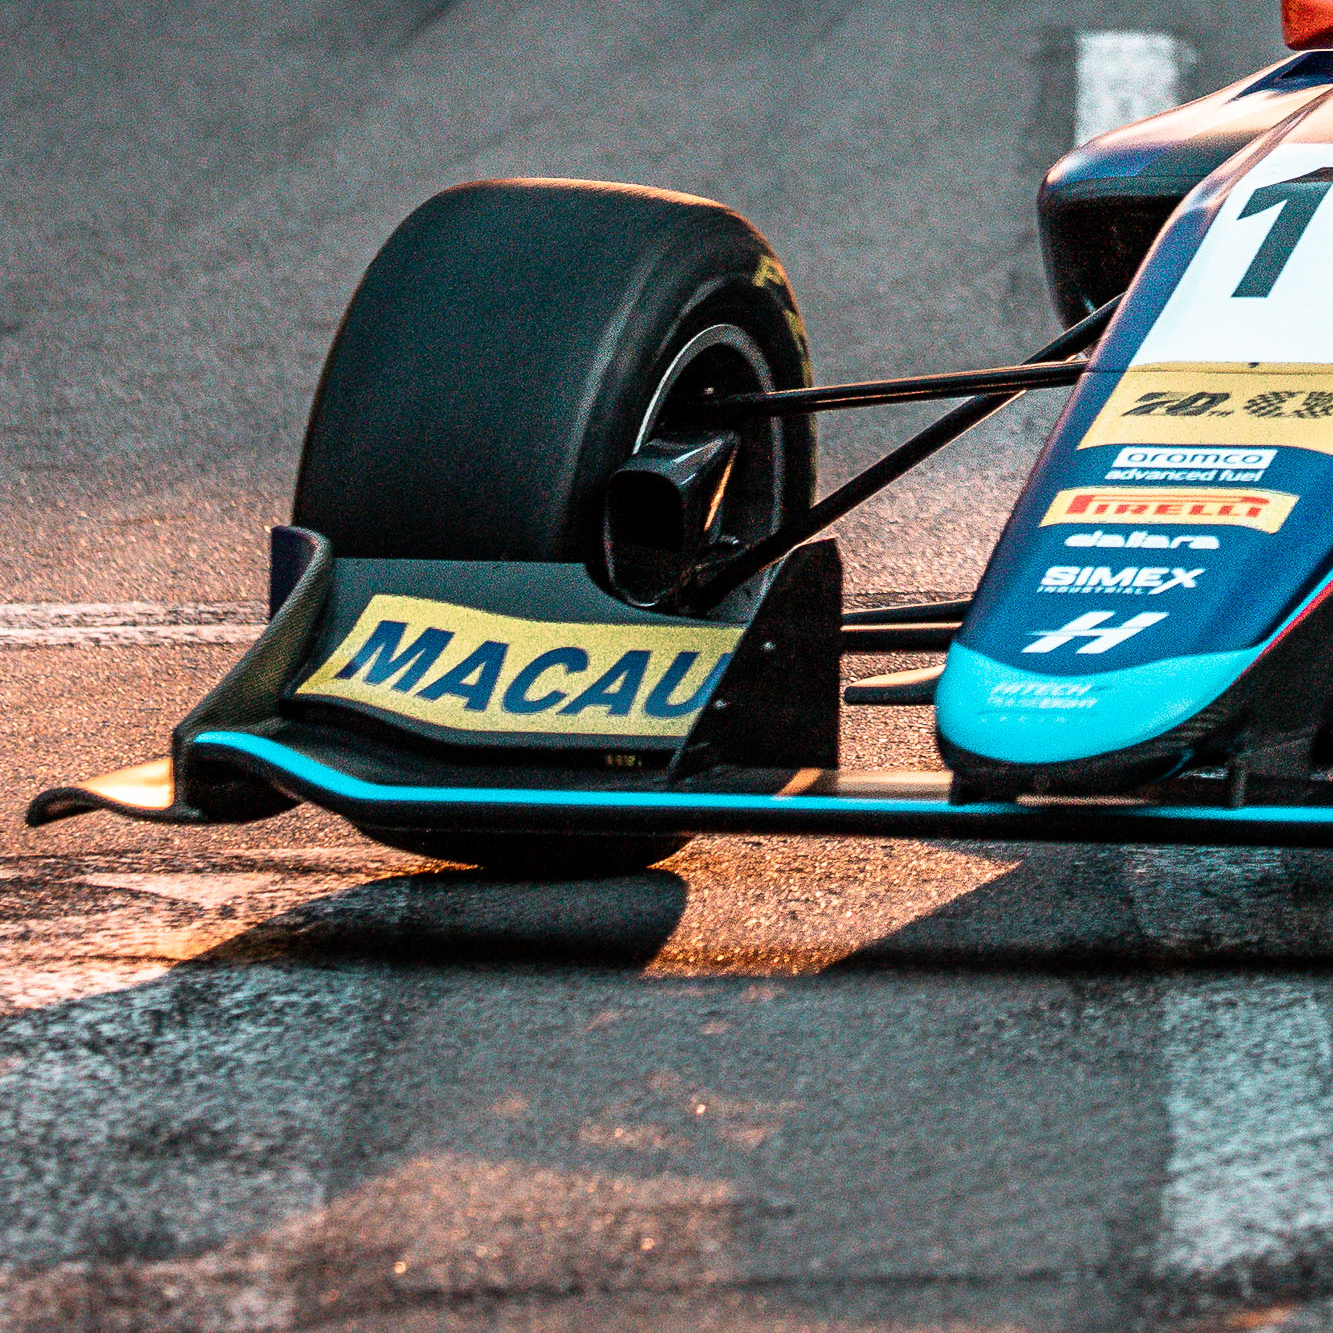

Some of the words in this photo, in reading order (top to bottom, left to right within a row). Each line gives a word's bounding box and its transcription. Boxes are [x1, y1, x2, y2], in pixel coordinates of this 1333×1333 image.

[1126, 451, 1264, 465] aramco
[1104, 468, 1216, 481] advanced
[1218, 469, 1265, 483] fuel
[1065, 494, 1270, 518] PIRELLI
[1064, 530, 1220, 550] dallara
[1041, 566, 1206, 595] SIMEX
[336, 619, 734, 719] MACAU
